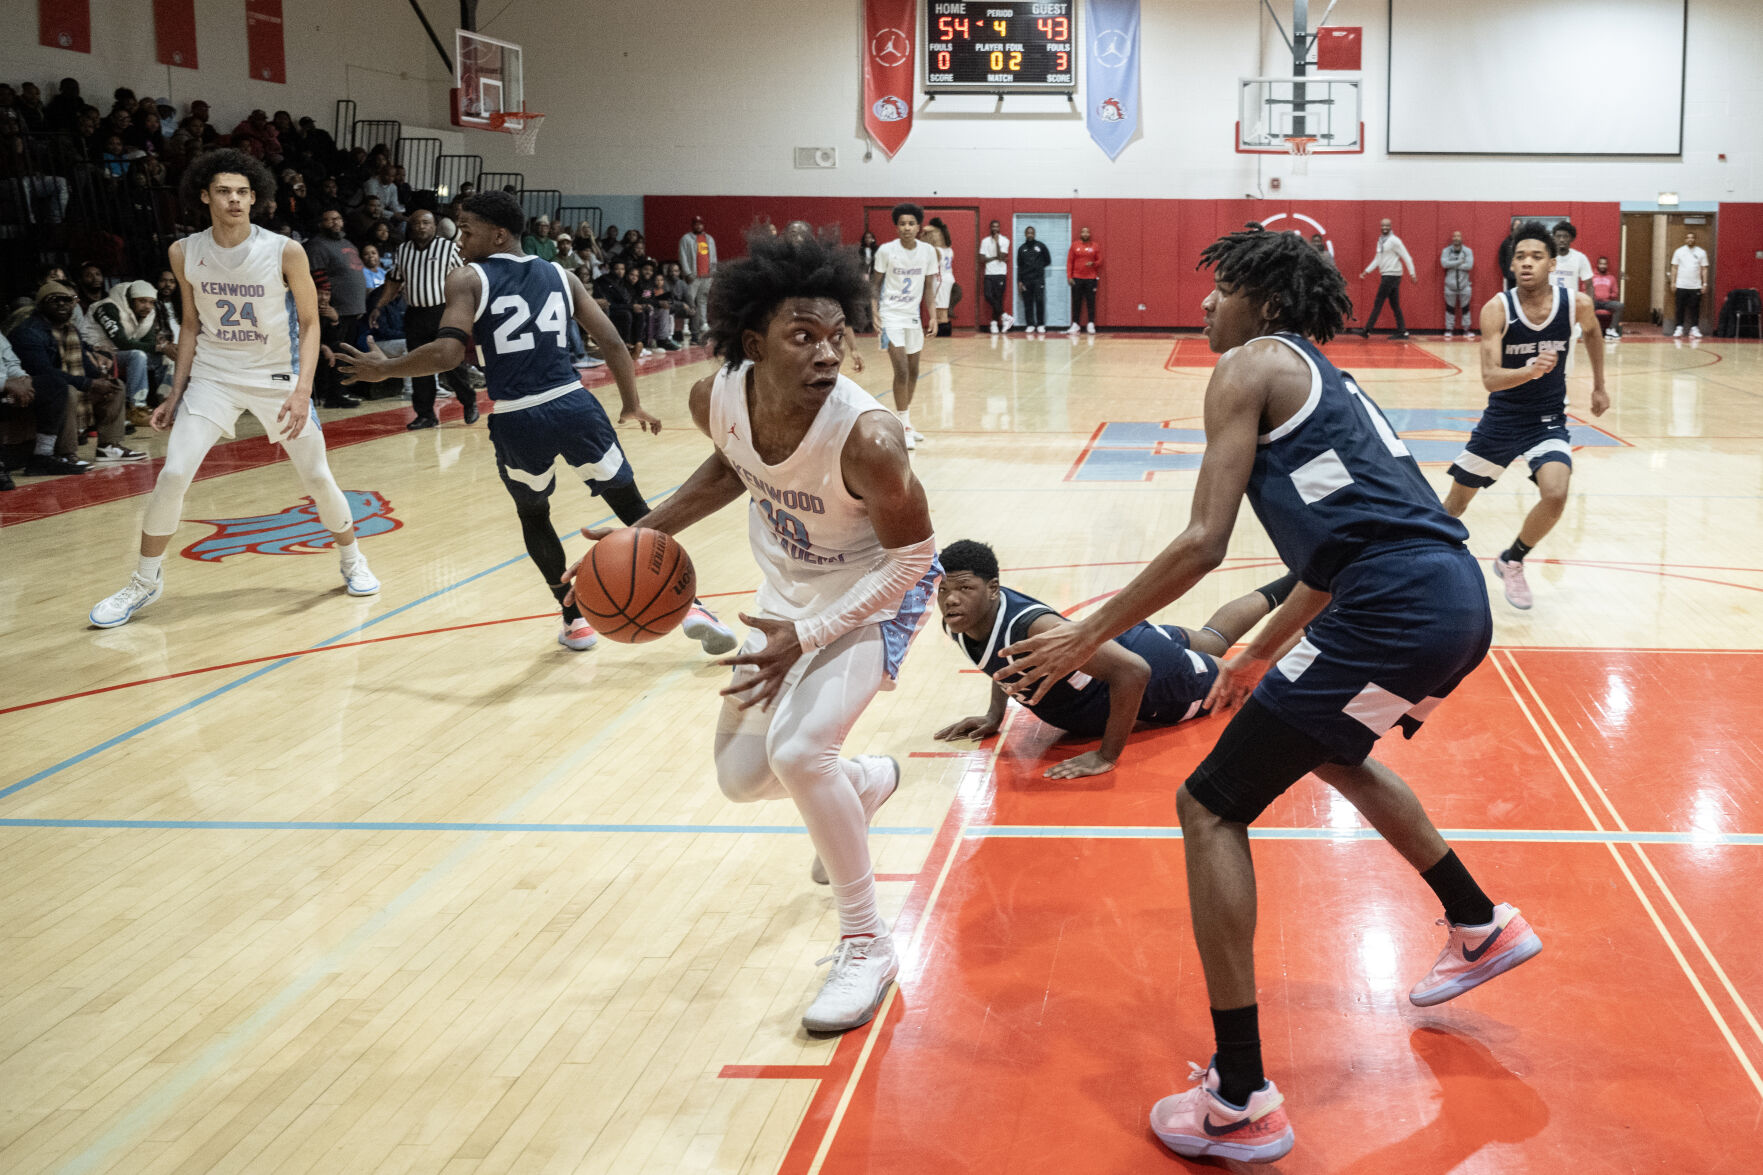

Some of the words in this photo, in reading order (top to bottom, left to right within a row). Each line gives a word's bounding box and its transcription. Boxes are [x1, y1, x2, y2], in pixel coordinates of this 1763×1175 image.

[935, 3, 966, 14] HOME
[987, 9, 1013, 18] PERIOD
[1032, 3, 1067, 15] GUEST
[938, 16, 969, 40] 54
[993, 20, 1006, 37] 4
[1037, 17, 1068, 41] 43
[929, 43, 953, 52] FOULS
[975, 43, 1004, 52] PLAYER
[1005, 43, 1024, 52] FOUL
[1046, 43, 1070, 52] FOULS
[937, 51, 951, 70] 0
[1056, 51, 1068, 71] 3
[929, 73, 954, 82] SCORE
[987, 73, 1014, 82] MATCH
[1046, 73, 1071, 82] SCORE
[201, 281, 265, 298] KENWOOD
[902, 277, 912, 294] 2
[216, 299, 258, 328] 24
[489, 291, 567, 355] 24
[1505, 343, 1537, 354] HYDE
